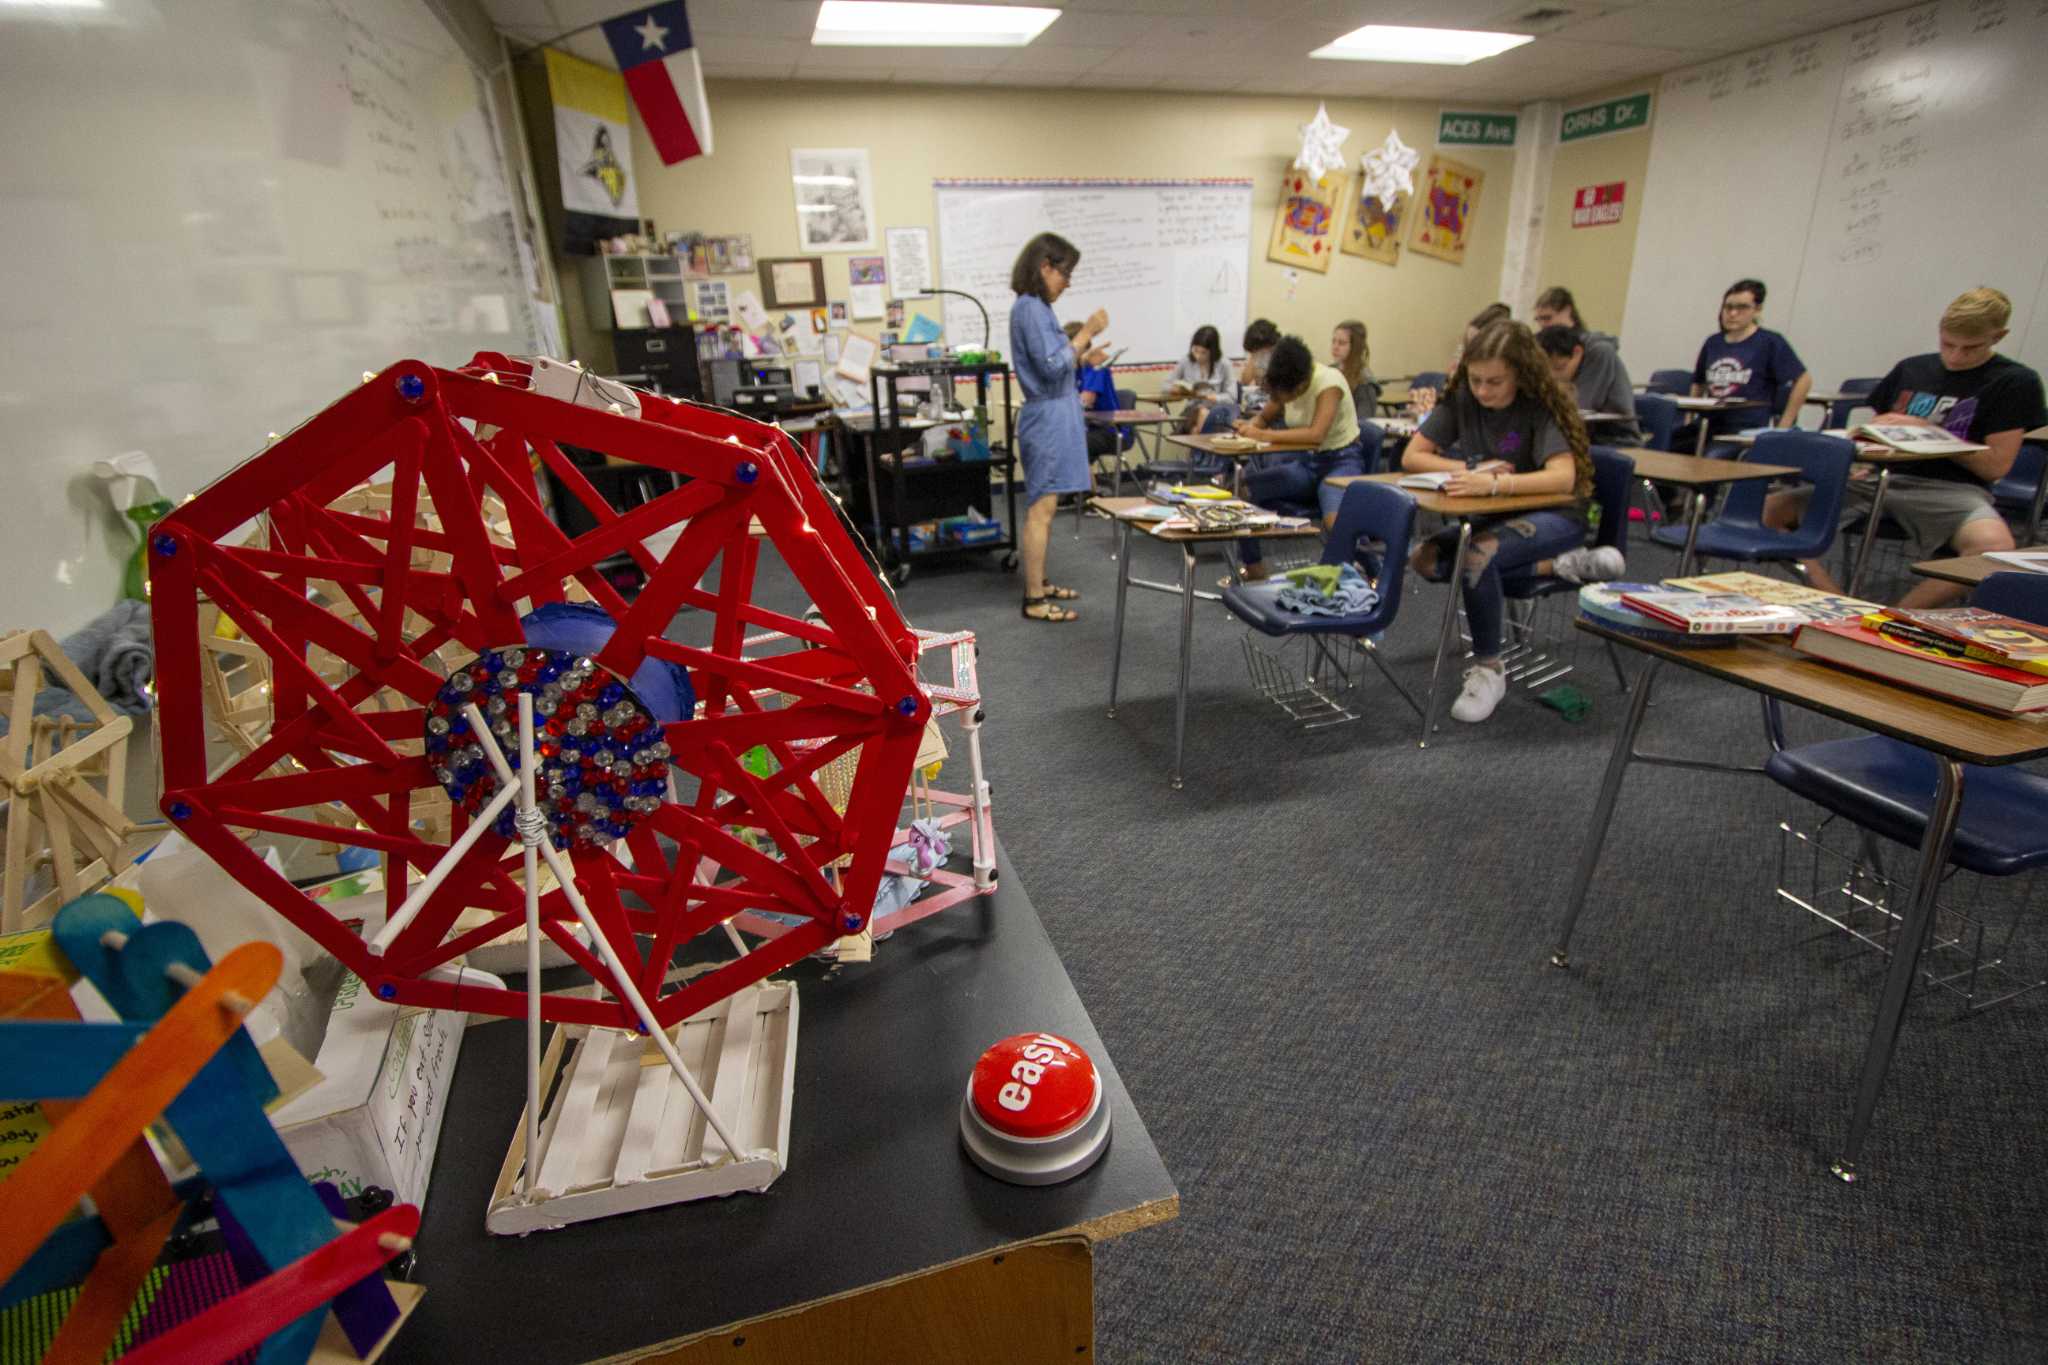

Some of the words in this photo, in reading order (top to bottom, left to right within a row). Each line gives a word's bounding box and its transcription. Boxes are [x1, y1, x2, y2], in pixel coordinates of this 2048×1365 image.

[1442, 119, 1481, 138] ACES
[1614, 103, 1638, 125] Dr.
[998, 1033, 1073, 1112] easy
[395, 1115, 407, 1154] If
